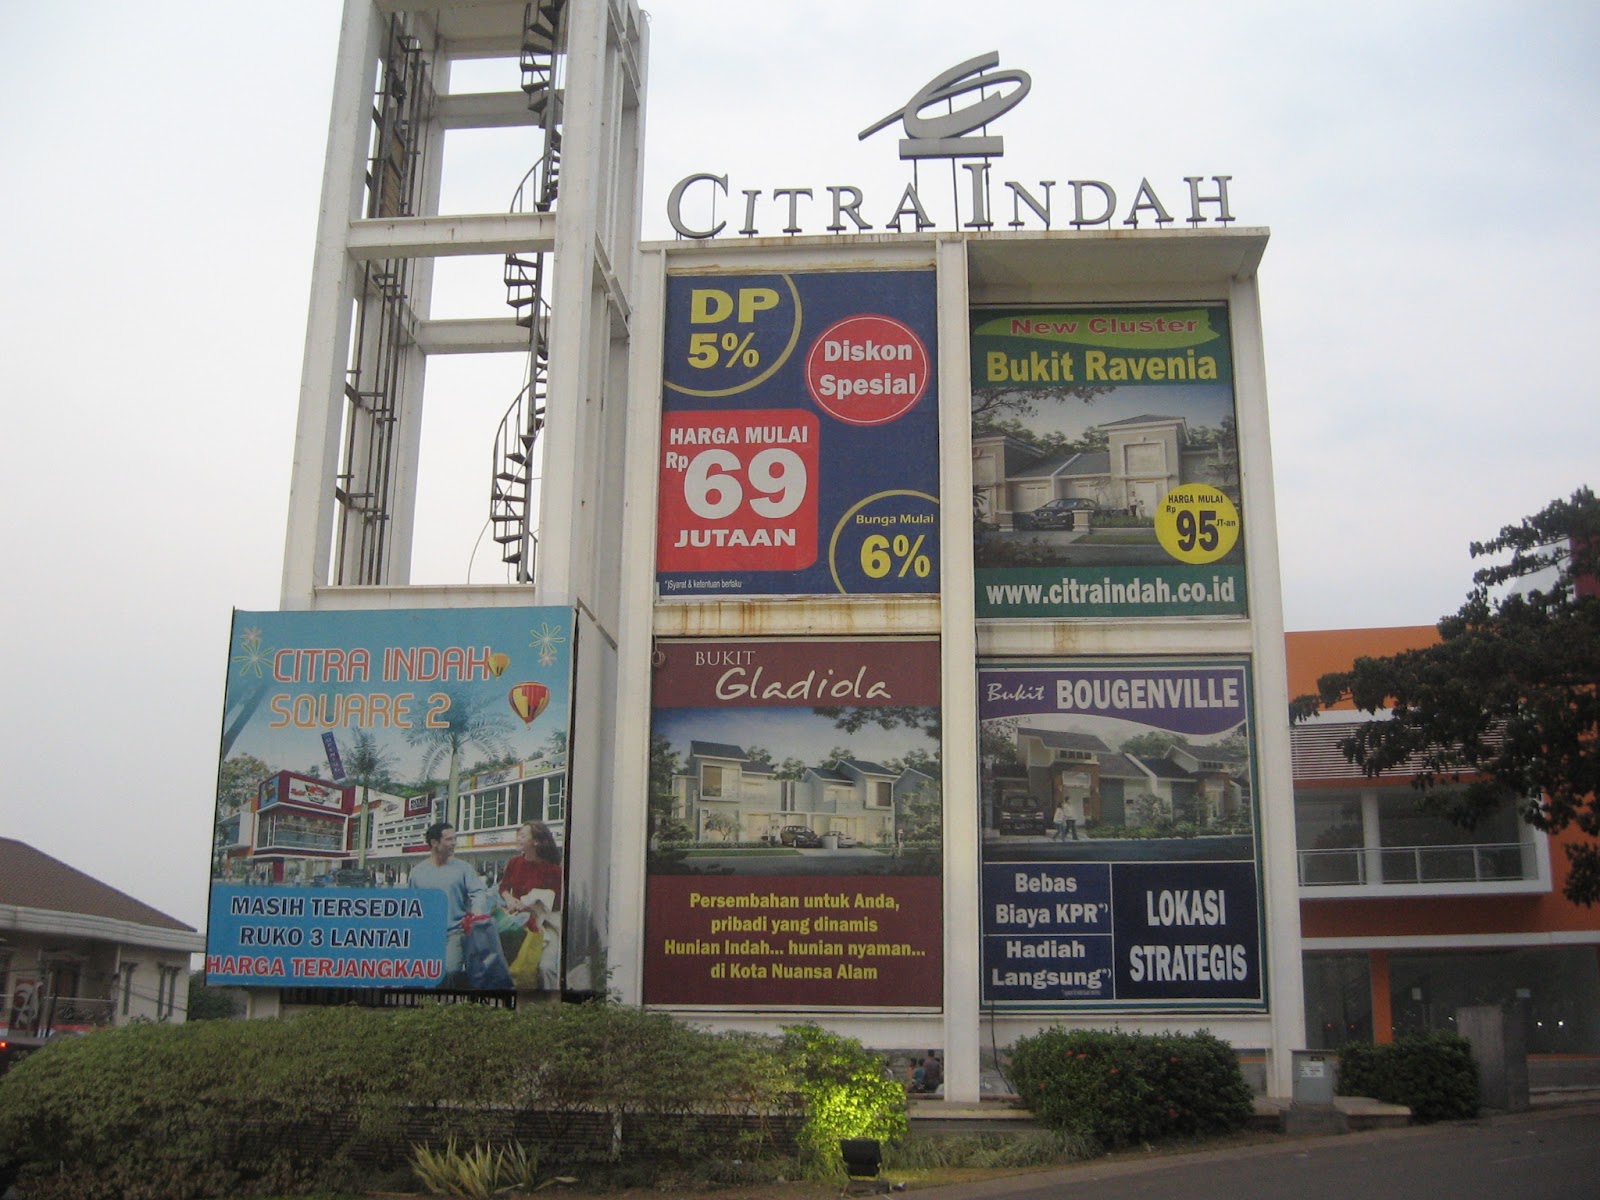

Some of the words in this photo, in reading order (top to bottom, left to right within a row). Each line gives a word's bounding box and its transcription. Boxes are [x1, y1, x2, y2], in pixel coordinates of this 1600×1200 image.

[690, 288, 780, 324] DP
[1010, 318, 1076, 335] New
[1088, 317, 1198, 335] Cluster
[687, 332, 760, 369] 5%
[824, 339, 913, 363] Diskon
[986, 351, 1074, 383] Bukit
[1085, 350, 1218, 380] Ravenia
[818, 373, 916, 399] Spesial
[670, 427, 739, 445] HARGA
[745, 426, 808, 444] MULAI
[666, 452, 689, 472] Rp
[683, 448, 807, 519] 69
[1168, 495, 1194, 503] HARGA
[1198, 495, 1223, 503] MULAI
[856, 514, 897, 526] Bunga
[900, 513, 934, 524] Mulai
[1166, 505, 1176, 514] Rp
[1176, 510, 1219, 552] 95
[674, 529, 796, 547] JUTAAN
[860, 534, 931, 579] 6%
[688, 580, 693, 588] &
[986, 575, 1235, 605] www.citraindah.co.id
[273, 648, 370, 683] CITRA
[383, 647, 490, 682] INDAH
[695, 651, 755, 666] BUKIT
[715, 665, 891, 700] Gladiola
[987, 683, 1044, 701] Bukit
[1056, 678, 1239, 709] BOUGENVILLE
[270, 693, 414, 729] SQUARE
[426, 693, 451, 729] 2
[1015, 873, 1077, 893] Bebas
[231, 896, 303, 917] MASIH
[311, 897, 424, 918] TERSEDIA
[690, 893, 799, 908] Persembahan
[804, 893, 850, 908] untuk
[854, 893, 900, 911] Anda,
[1147, 890, 1226, 926] LOKASI
[711, 916, 767, 934] pribadi
[771, 918, 810, 935] yang
[814, 917, 878, 932] dinamis
[995, 904, 1050, 928] Biaya
[240, 927, 303, 947] RUKO
[310, 928, 323, 947] 3
[330, 928, 411, 948] LANTAI
[664, 940, 720, 955] Hunian
[725, 940, 784, 955] Indah...
[789, 940, 843, 955] hunian
[848, 943, 926, 958] nyaman...
[1006, 940, 1085, 958] Hadiah
[206, 956, 285, 977] HARGA
[292, 957, 442, 980] TERJANGKAU
[711, 963, 726, 978] di
[730, 963, 767, 979] Kota
[772, 963, 832, 979] Nuansa
[837, 964, 877, 979] Alam
[1130, 944, 1248, 982] STRATEGIS
